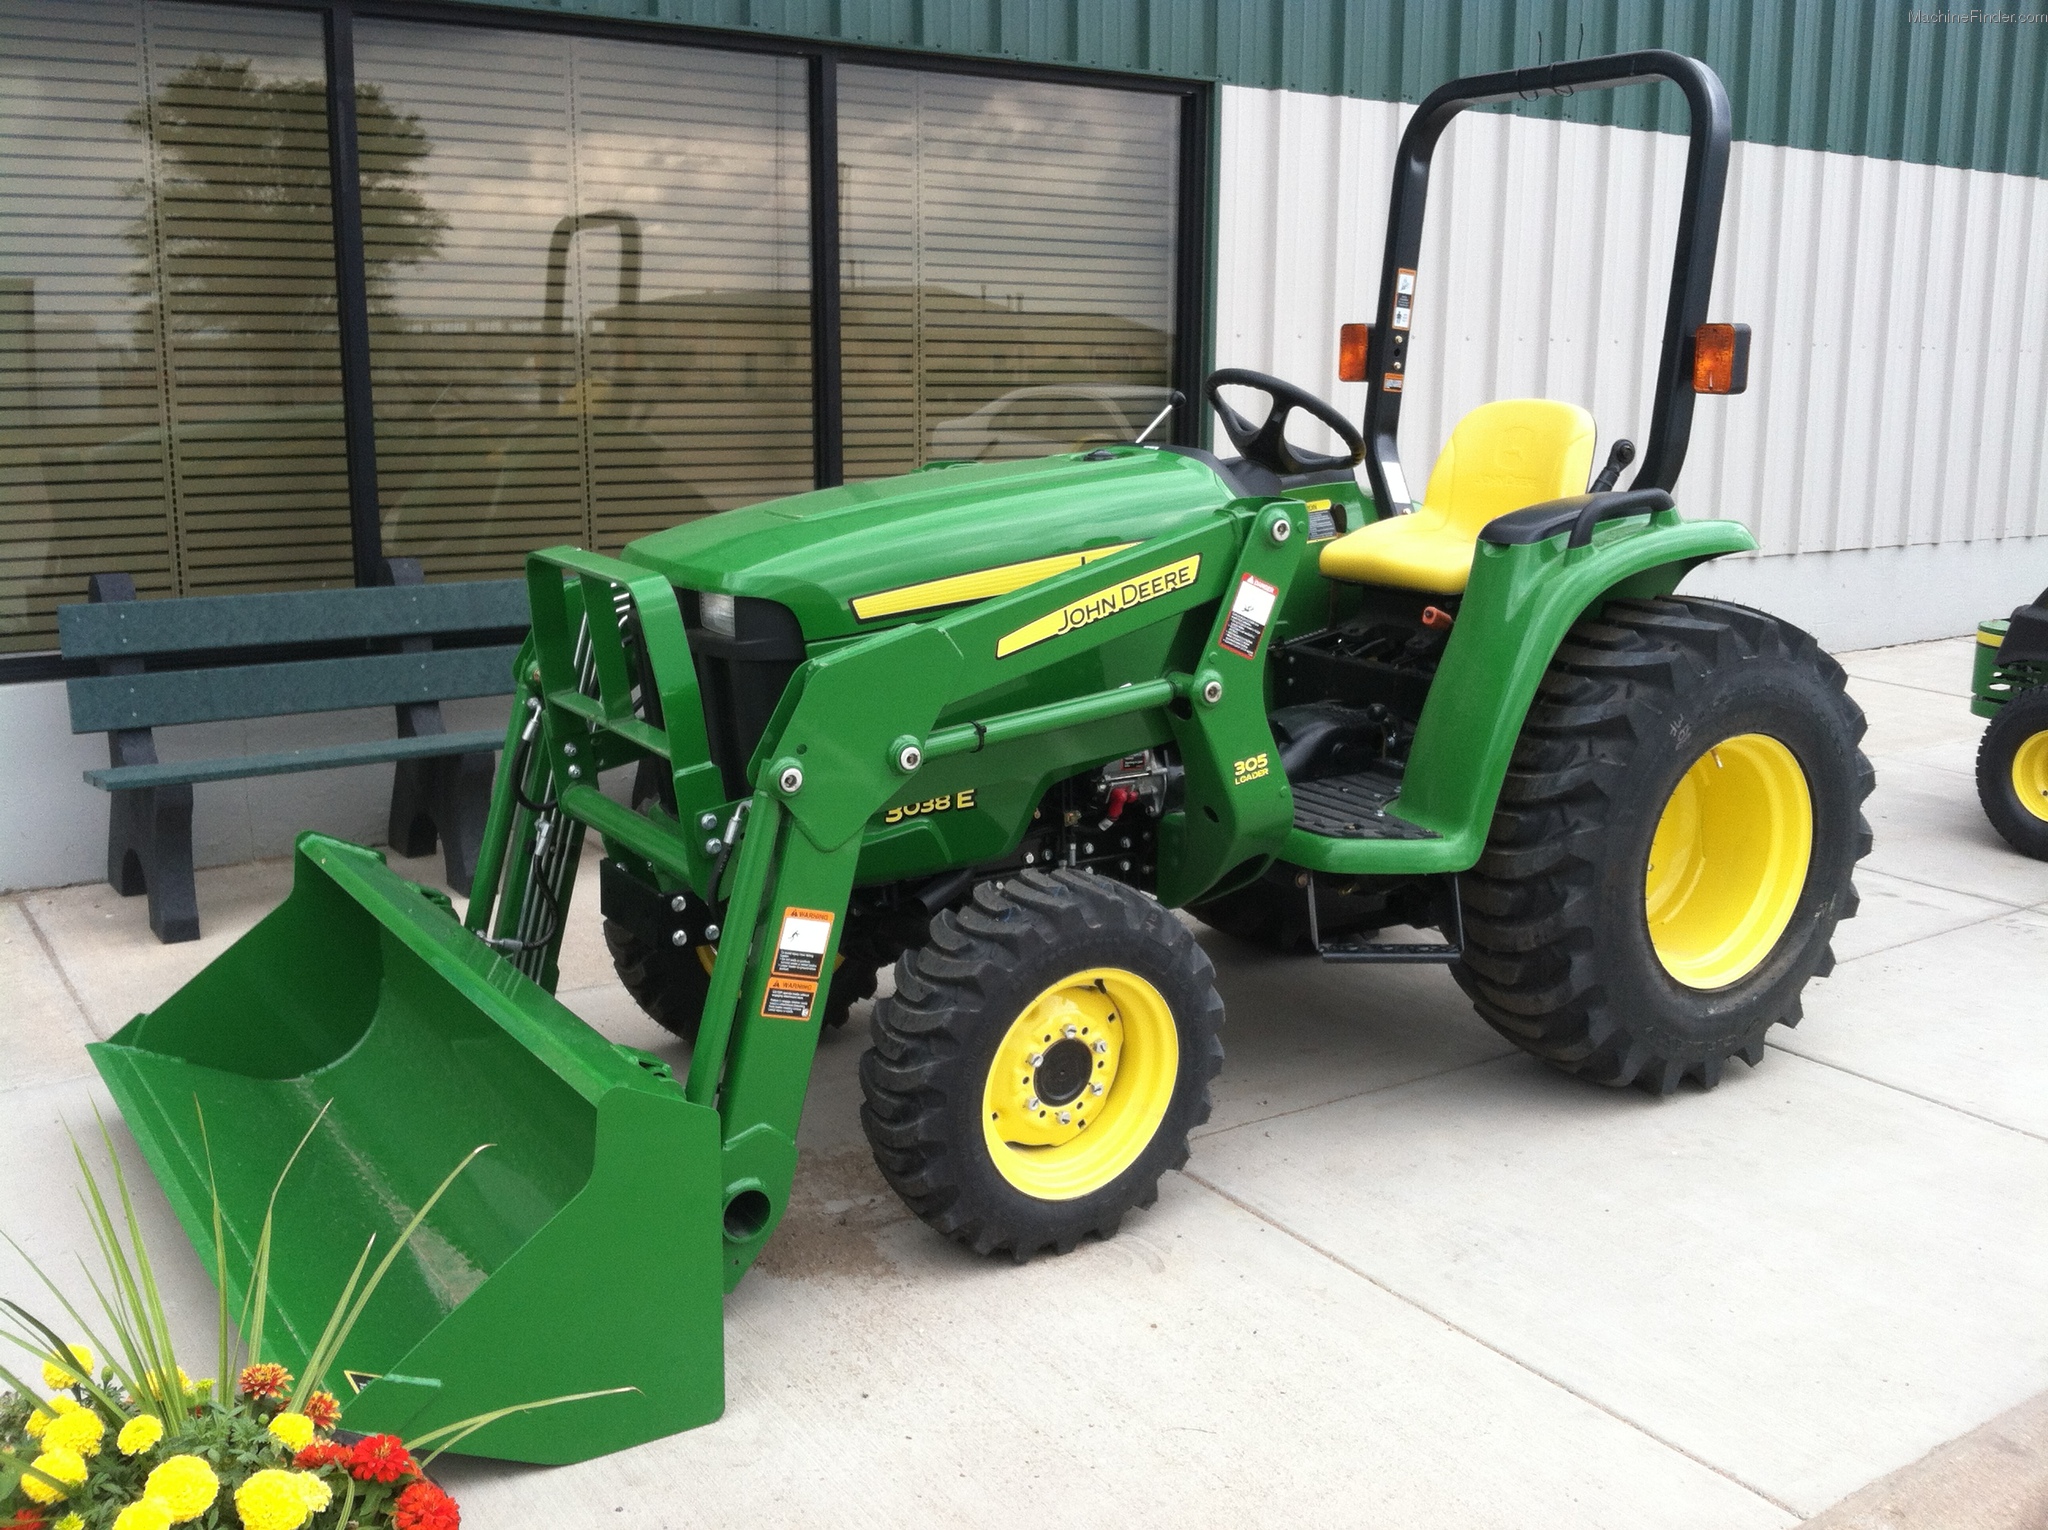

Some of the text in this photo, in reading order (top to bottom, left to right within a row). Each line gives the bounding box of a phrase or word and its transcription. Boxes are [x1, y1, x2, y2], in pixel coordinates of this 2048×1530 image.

[1057, 566, 1191, 633] JOHN DEERE
[1233, 753, 1268, 776] 305
[1234, 768, 1269, 785] LOADER
[799, 911, 829, 921] WARNING
[782, 981, 813, 991] WARNING
